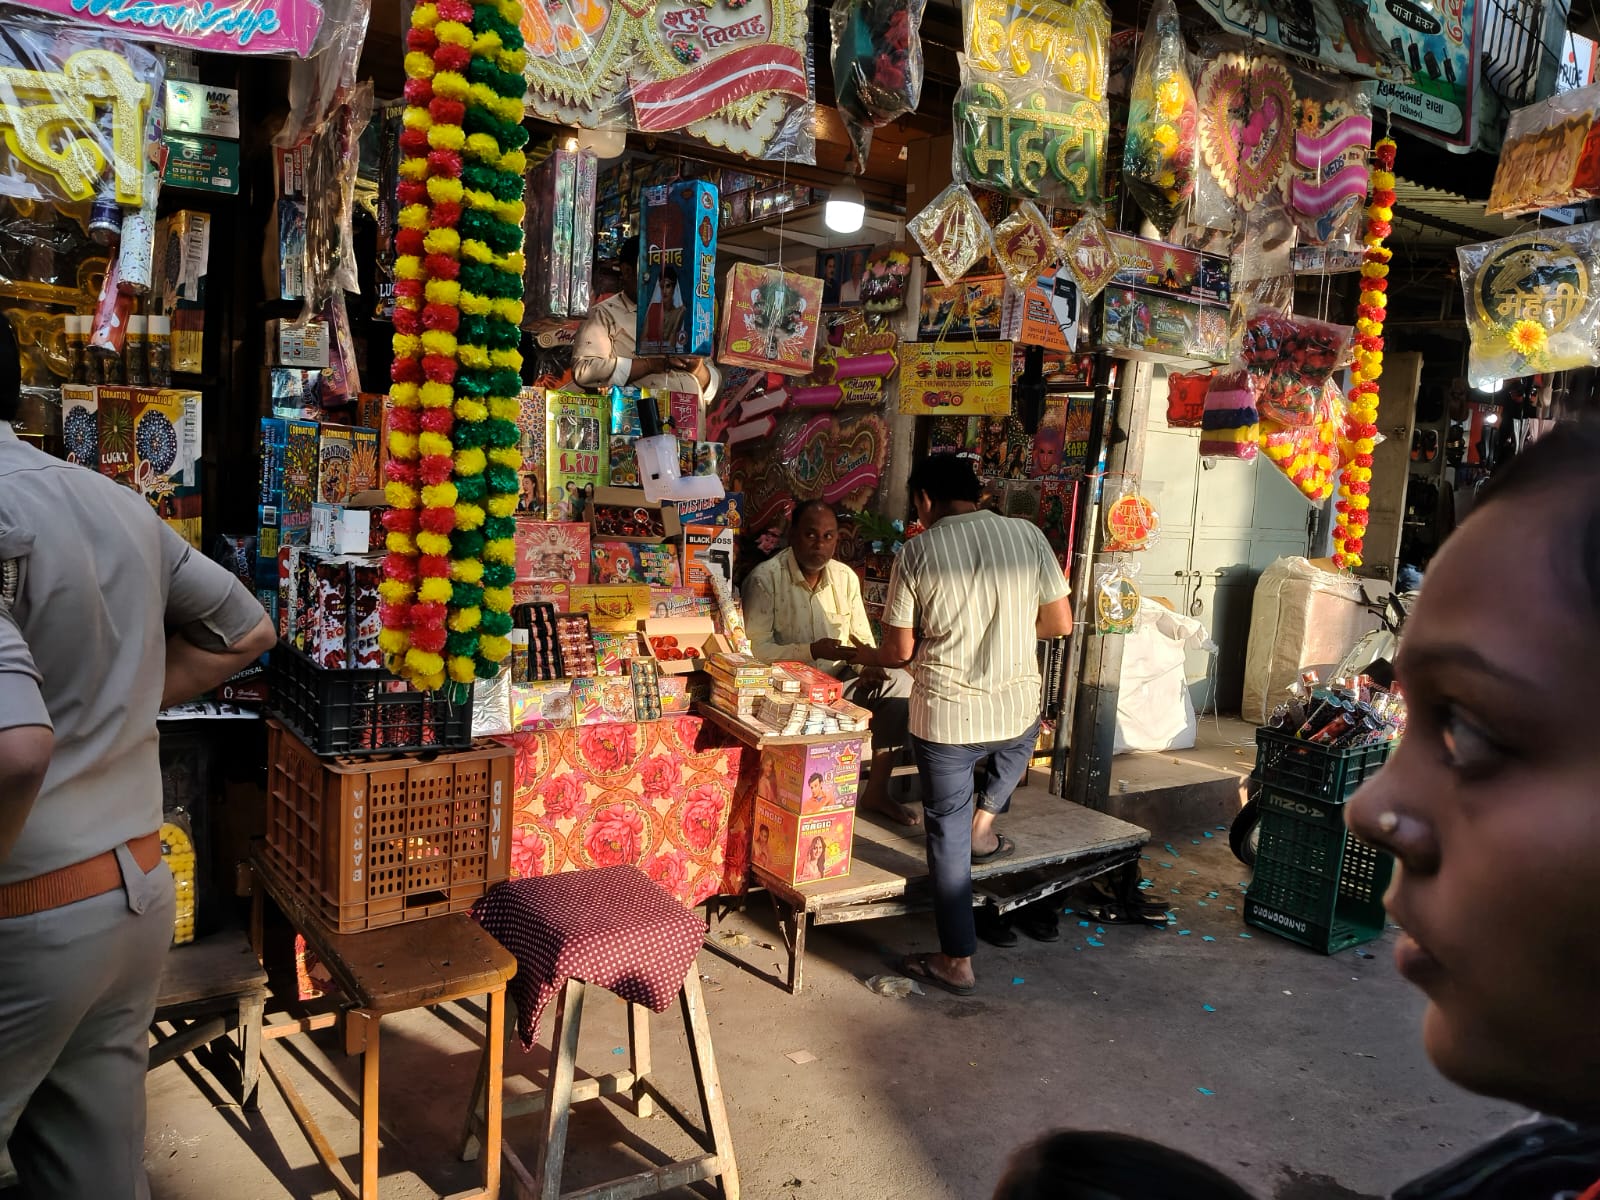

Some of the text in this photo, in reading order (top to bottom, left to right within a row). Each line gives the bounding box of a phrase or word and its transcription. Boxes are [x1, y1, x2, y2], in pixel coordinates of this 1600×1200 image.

[71, 0, 280, 46] arriage
[663, 6, 709, 39] शुभ
[701, 14, 766, 48] विवाह
[206, 91, 230, 103] MAX
[648, 244, 684, 268] विवाह
[1067, 441, 1087, 449] CADD
[102, 451, 129, 464] LUCKY
[1067, 449, 1086, 457] SHAC
[689, 536, 710, 544] BLACK
[802, 820, 832, 832] MAGIC
